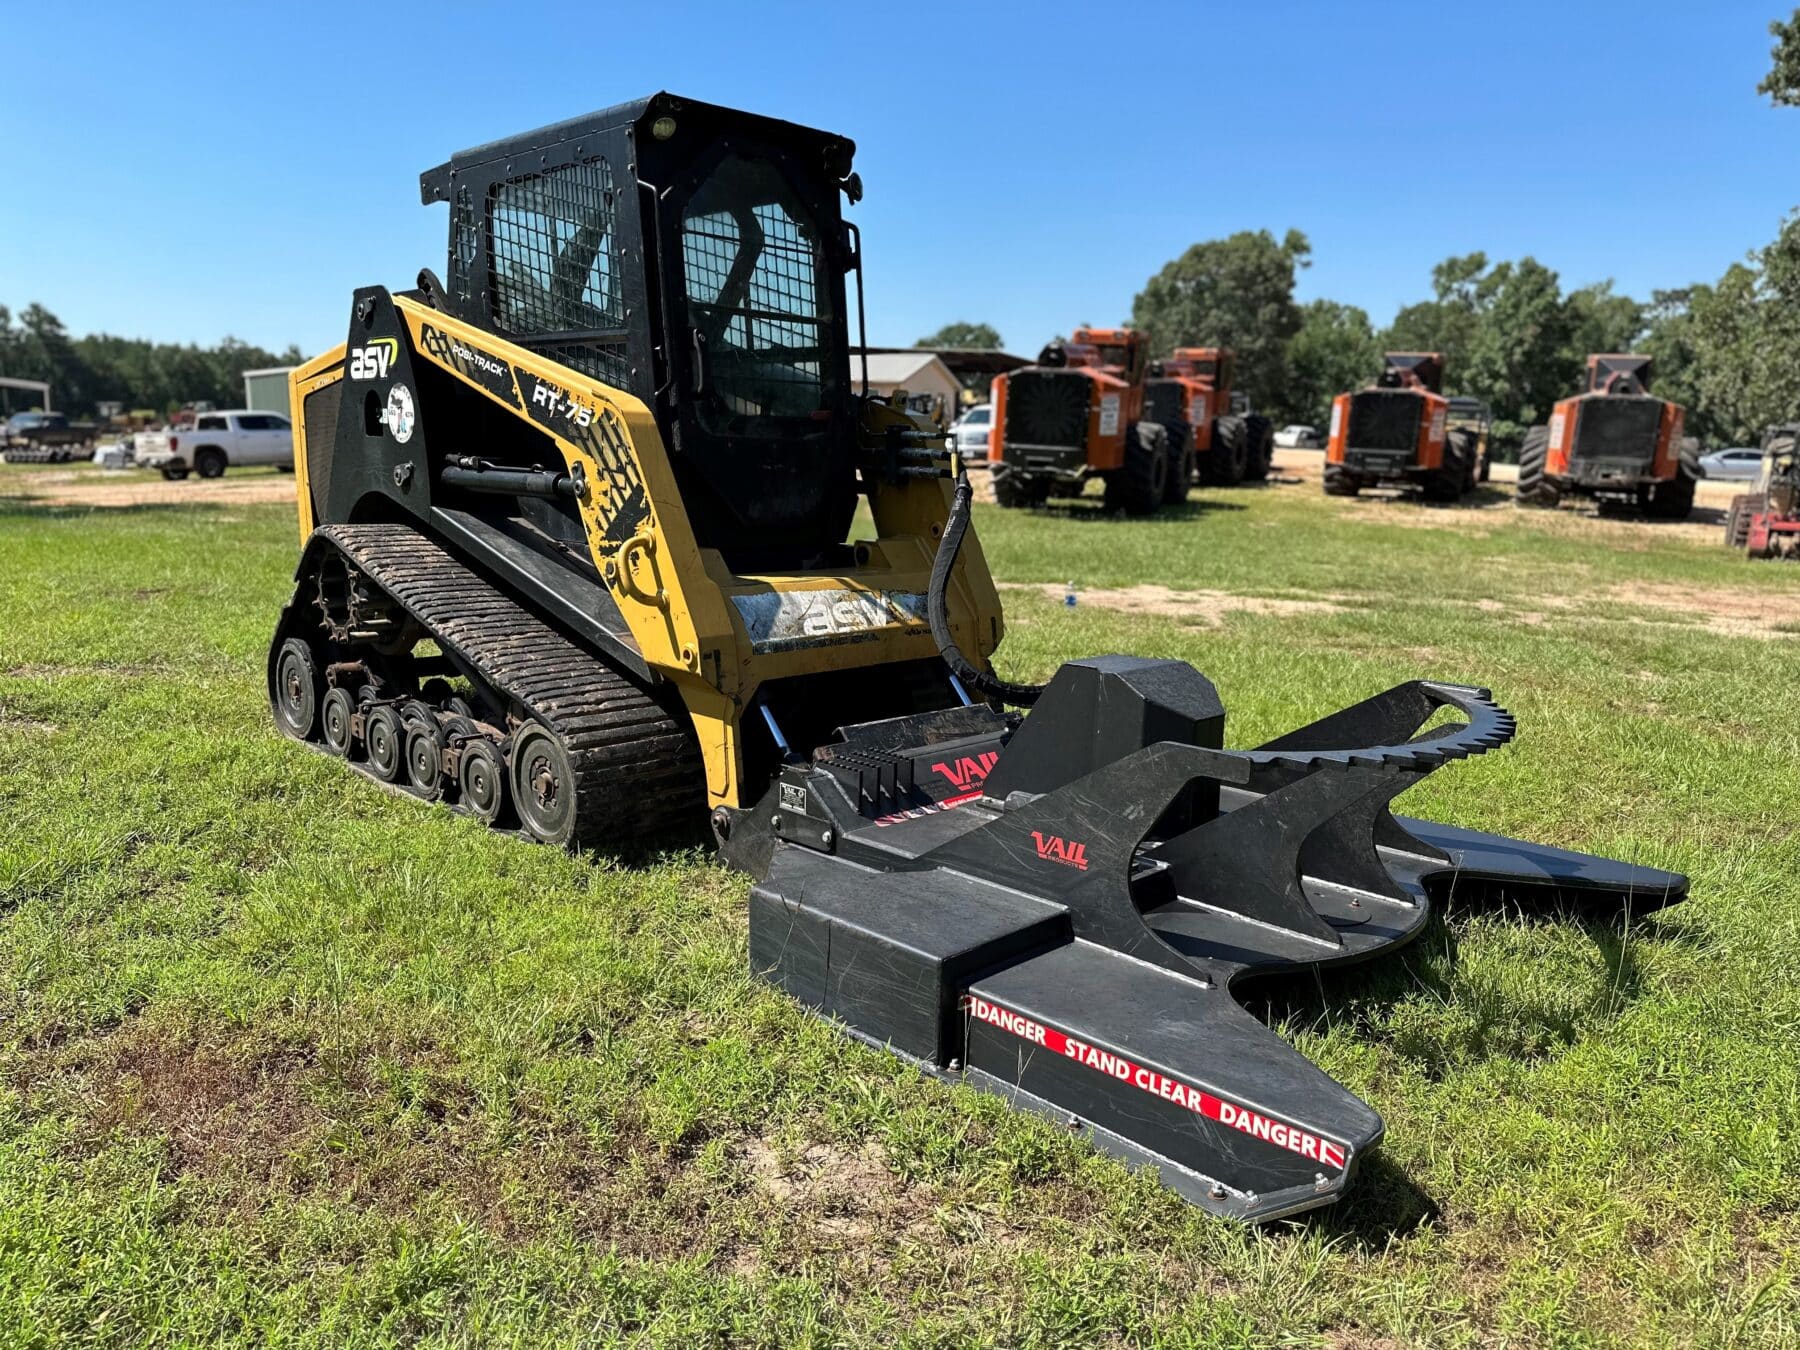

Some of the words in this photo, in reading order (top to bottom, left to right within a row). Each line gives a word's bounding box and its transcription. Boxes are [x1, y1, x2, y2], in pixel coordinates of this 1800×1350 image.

[452, 345, 503, 377] POSI-TRACK
[532, 384, 592, 427] RT-75
[1031, 831, 1089, 865] VAIL
[977, 1000, 1046, 1046] DANGER
[1064, 1038, 1131, 1081] STAND
[1135, 1068, 1202, 1113] CLEAR
[1219, 1104, 1318, 1160] DANGER
